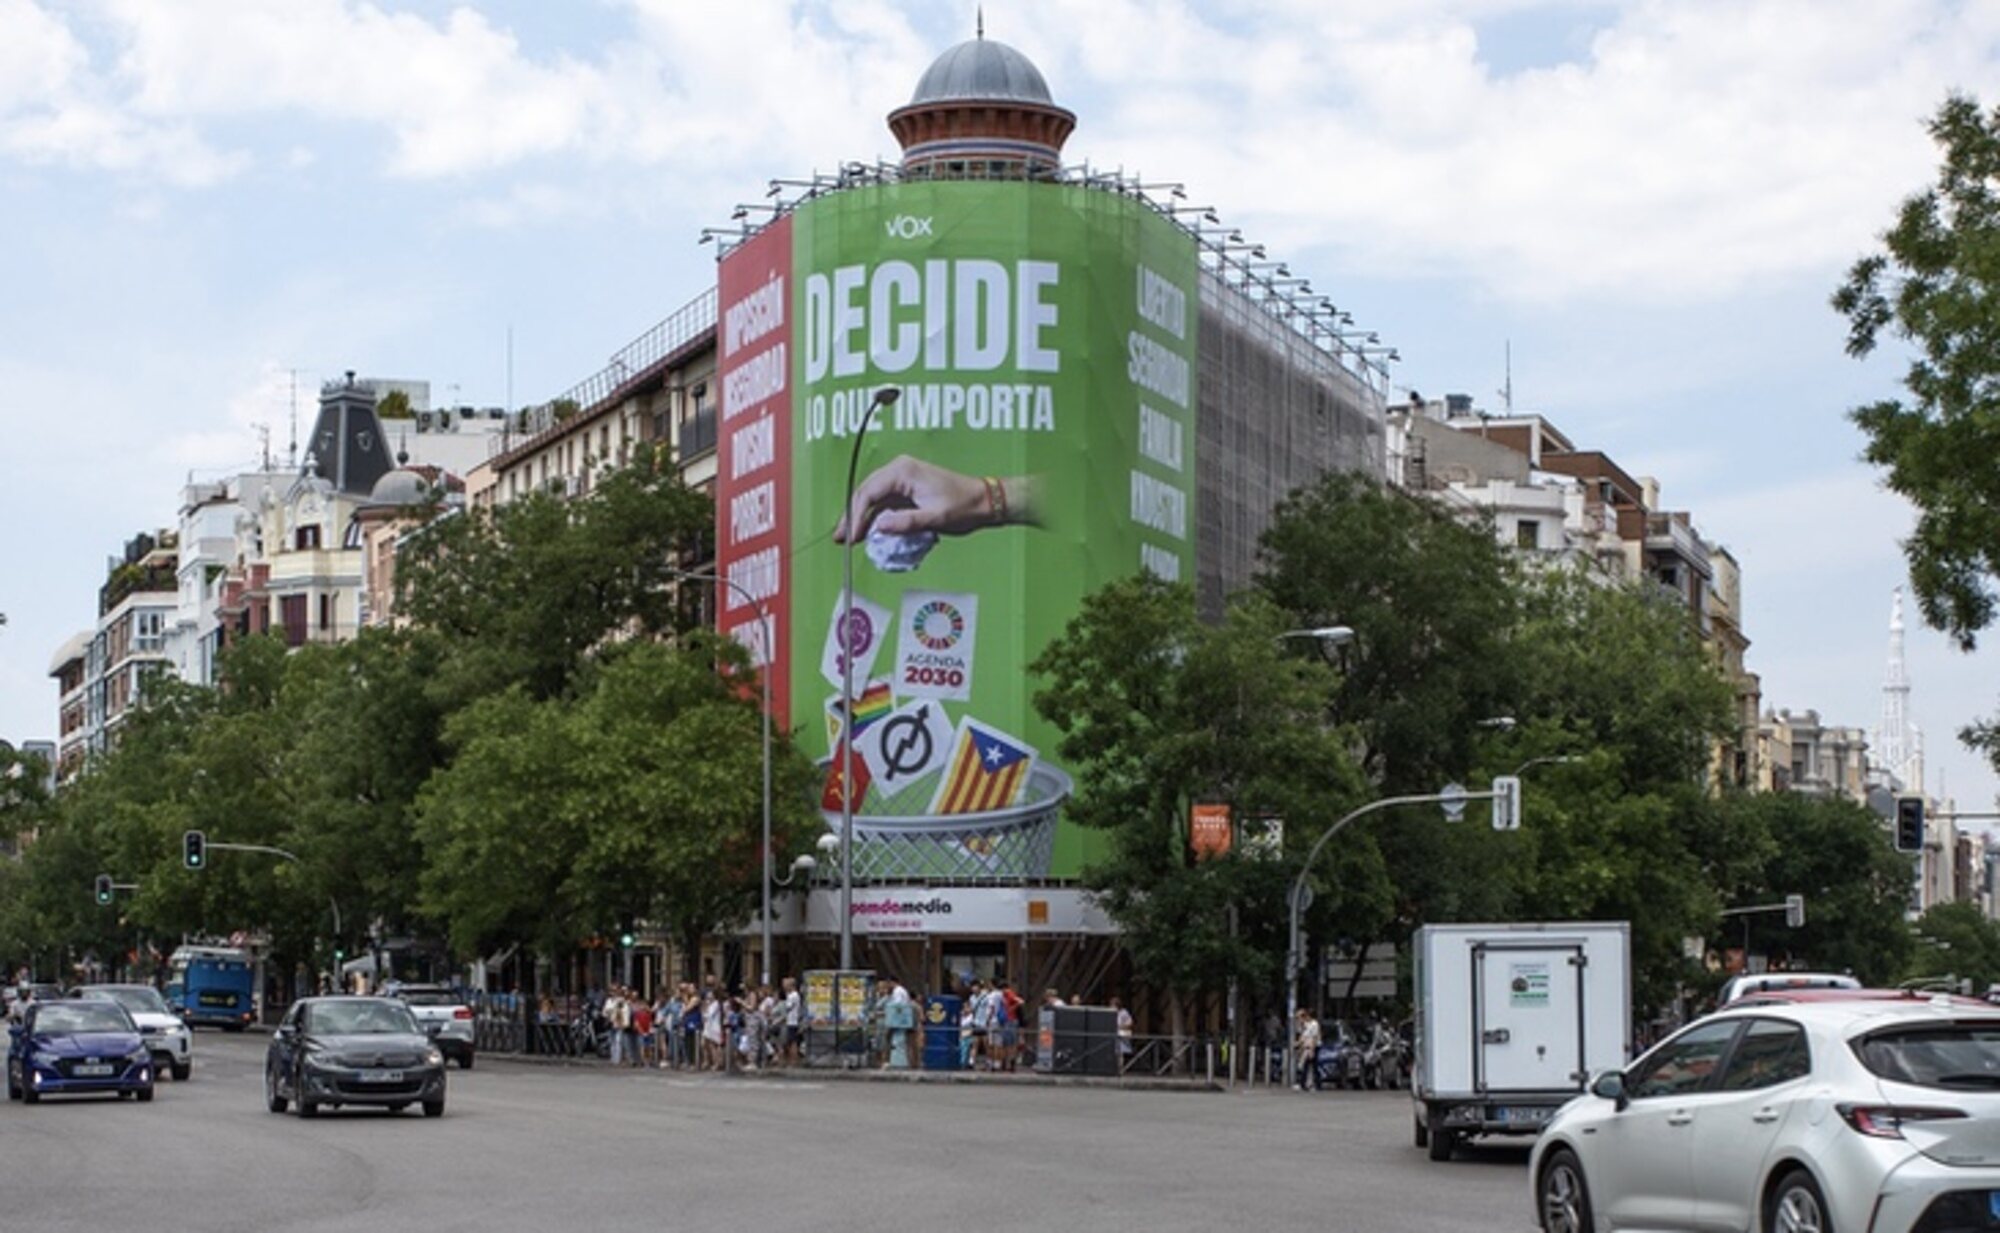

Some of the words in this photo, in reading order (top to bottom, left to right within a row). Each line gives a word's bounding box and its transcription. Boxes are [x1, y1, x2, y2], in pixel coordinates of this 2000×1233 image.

[885, 214, 933, 240] VOX
[805, 259, 1060, 385] DECIDE
[806, 394, 825, 442] LO
[895, 384, 1055, 432] IMPORTA
[905, 653, 965, 669] AGENDA
[905, 666, 964, 687] 2030
